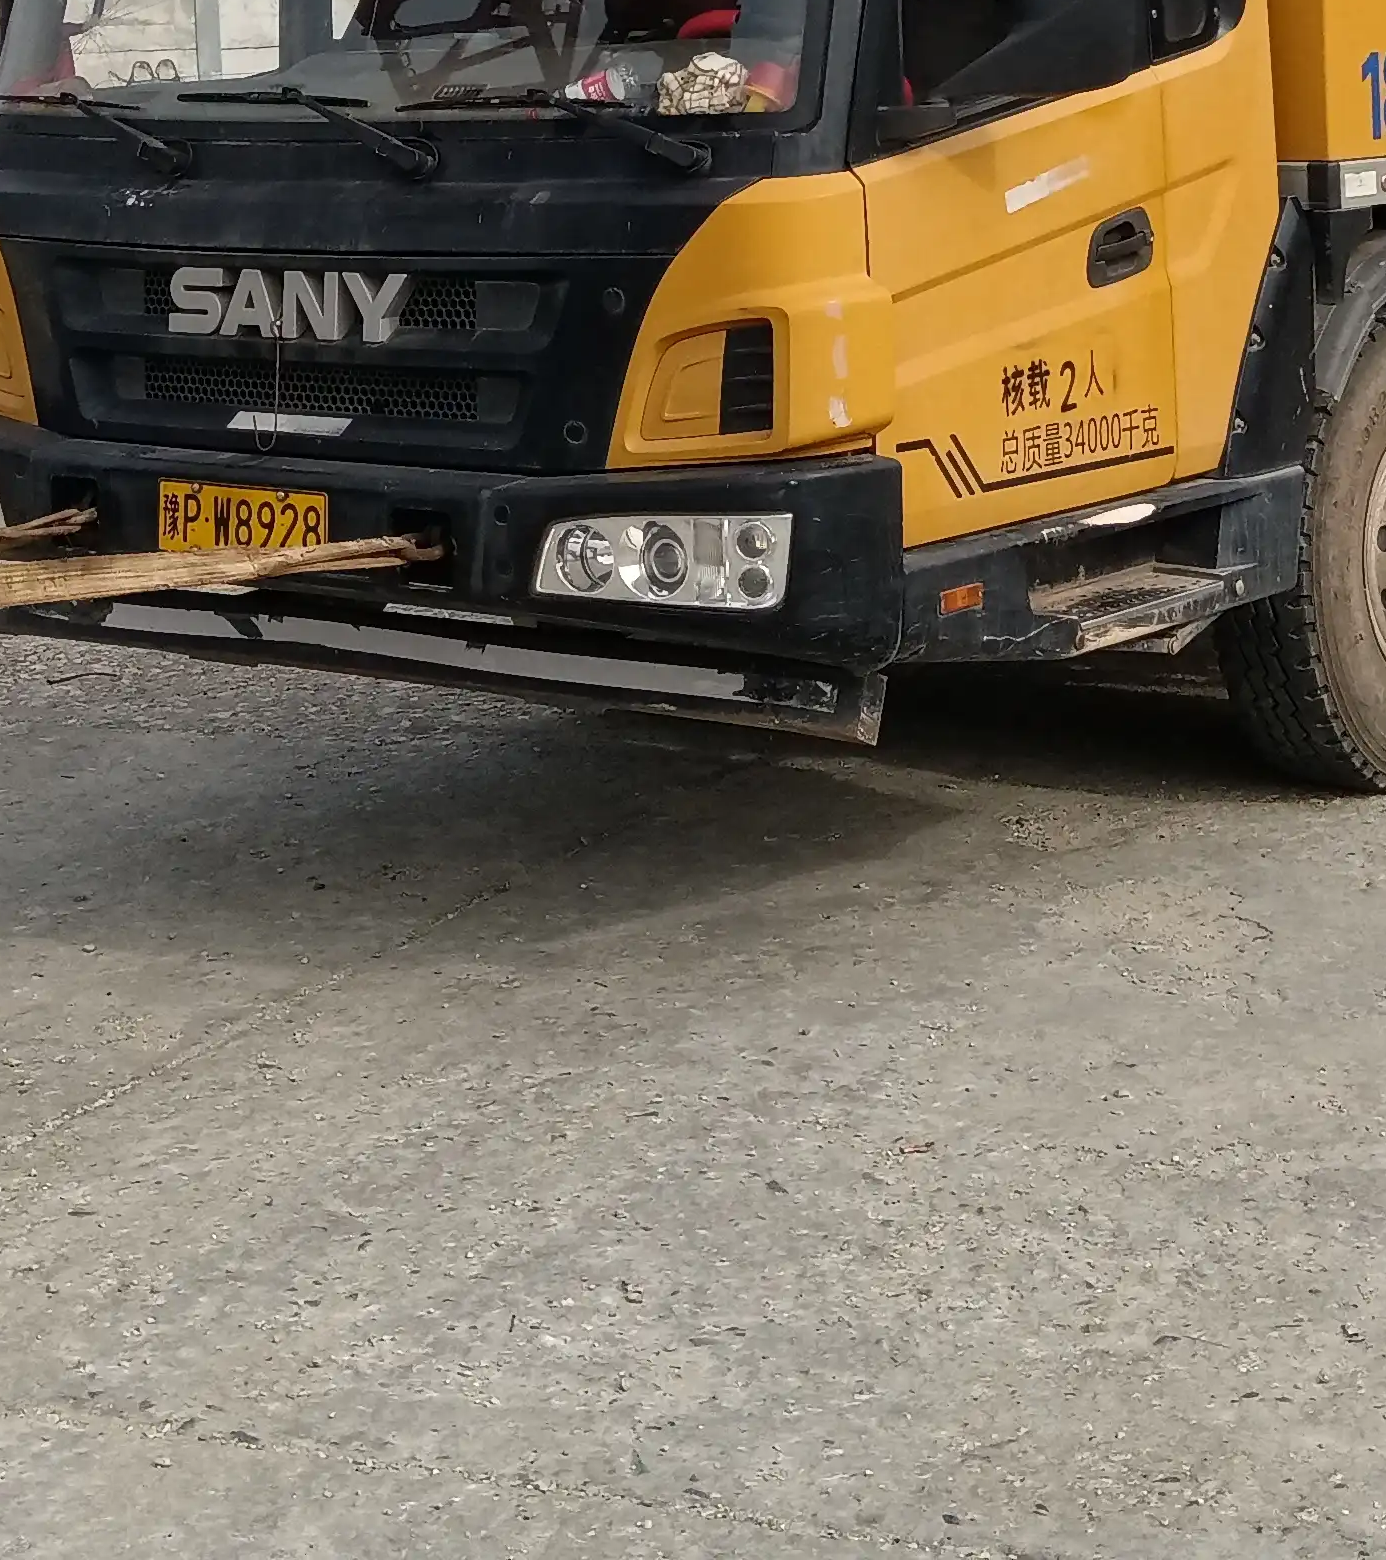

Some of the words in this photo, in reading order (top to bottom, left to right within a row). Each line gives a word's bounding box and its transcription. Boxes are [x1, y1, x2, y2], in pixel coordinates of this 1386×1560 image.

[168, 266, 410, 343] SANY
[1000, 403, 1160, 475] 总质量34000千克
